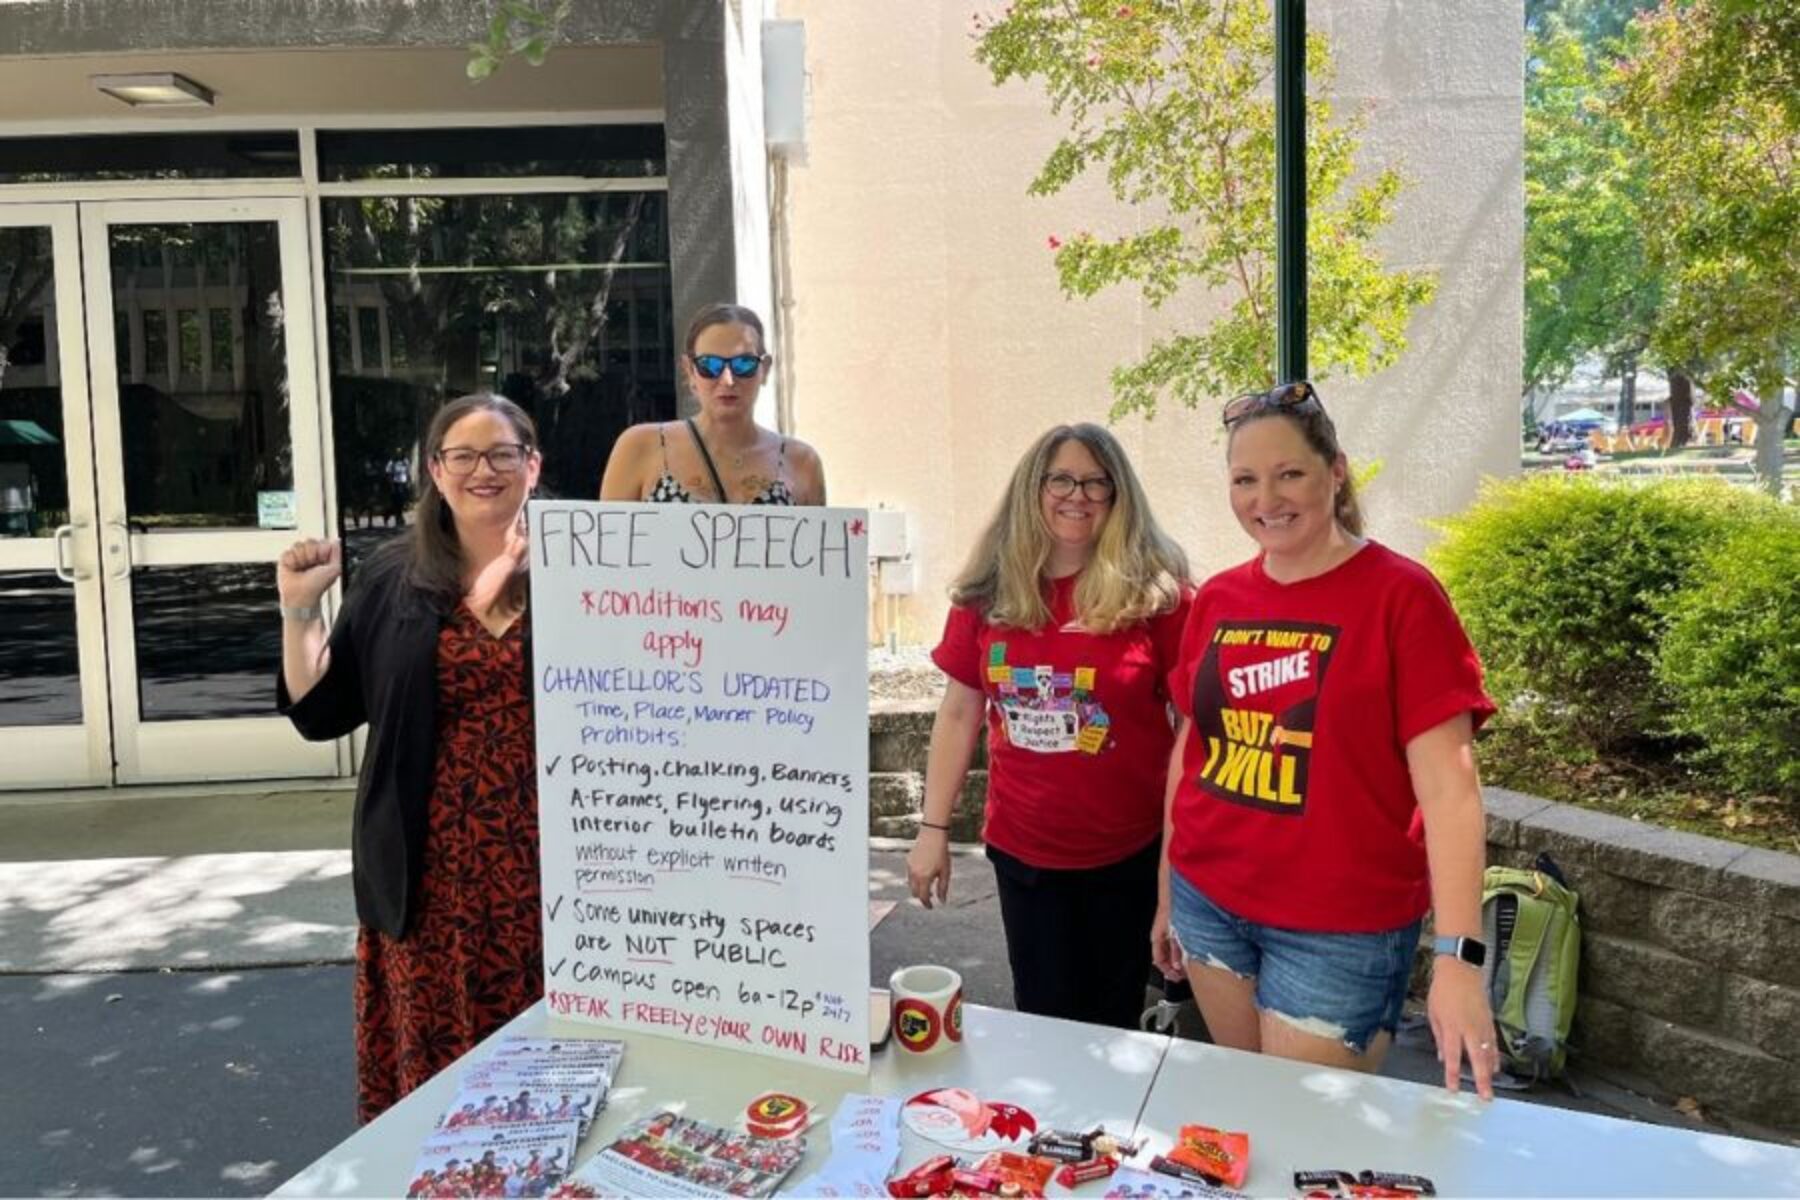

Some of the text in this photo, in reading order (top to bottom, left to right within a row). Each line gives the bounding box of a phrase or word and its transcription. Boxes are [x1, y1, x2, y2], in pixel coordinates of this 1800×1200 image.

[541, 509, 659, 568] FREE
[739, 599, 790, 636] may
[643, 630, 703, 667] apply
[1213, 629, 1332, 652] I DON'T WANT TO
[543, 666, 831, 703] CHANCELLOR'S UPDATED
[1228, 650, 1310, 699] STRIKE
[694, 706, 754, 724] Manner
[765, 708, 814, 734] Policy
[1220, 708, 1274, 747] BUT
[1201, 737, 1302, 804] I WILL
[669, 819, 758, 842] bulletin
[770, 821, 835, 852] boards
[575, 843, 786, 879] without explicit written
[575, 866, 655, 889] permission
[573, 898, 815, 942] Some university spaces
[575, 933, 787, 968] are NOT PUBLIC
[572, 960, 656, 991] Campus
[672, 978, 721, 1001] open
[762, 1026, 807, 1055] OWN
[819, 1036, 865, 1064] RISK
